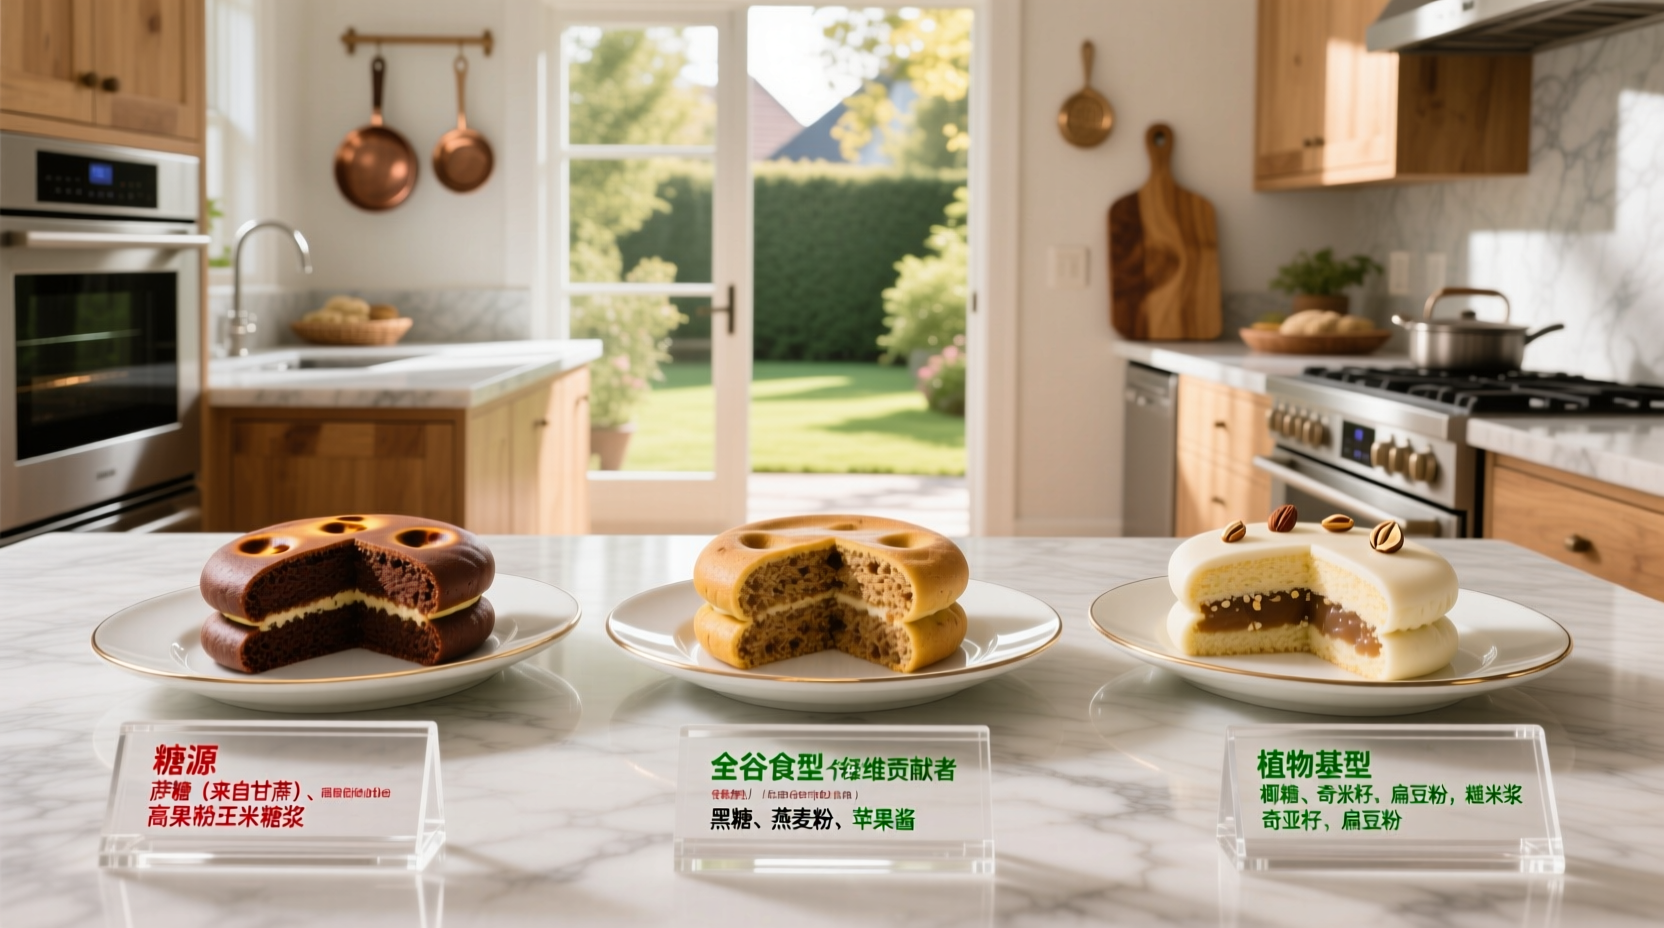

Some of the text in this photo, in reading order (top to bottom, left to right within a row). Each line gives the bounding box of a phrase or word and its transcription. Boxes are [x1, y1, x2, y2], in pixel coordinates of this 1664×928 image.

[152, 743, 219, 776] 糖源
[1256, 749, 1372, 779] 植物基型
